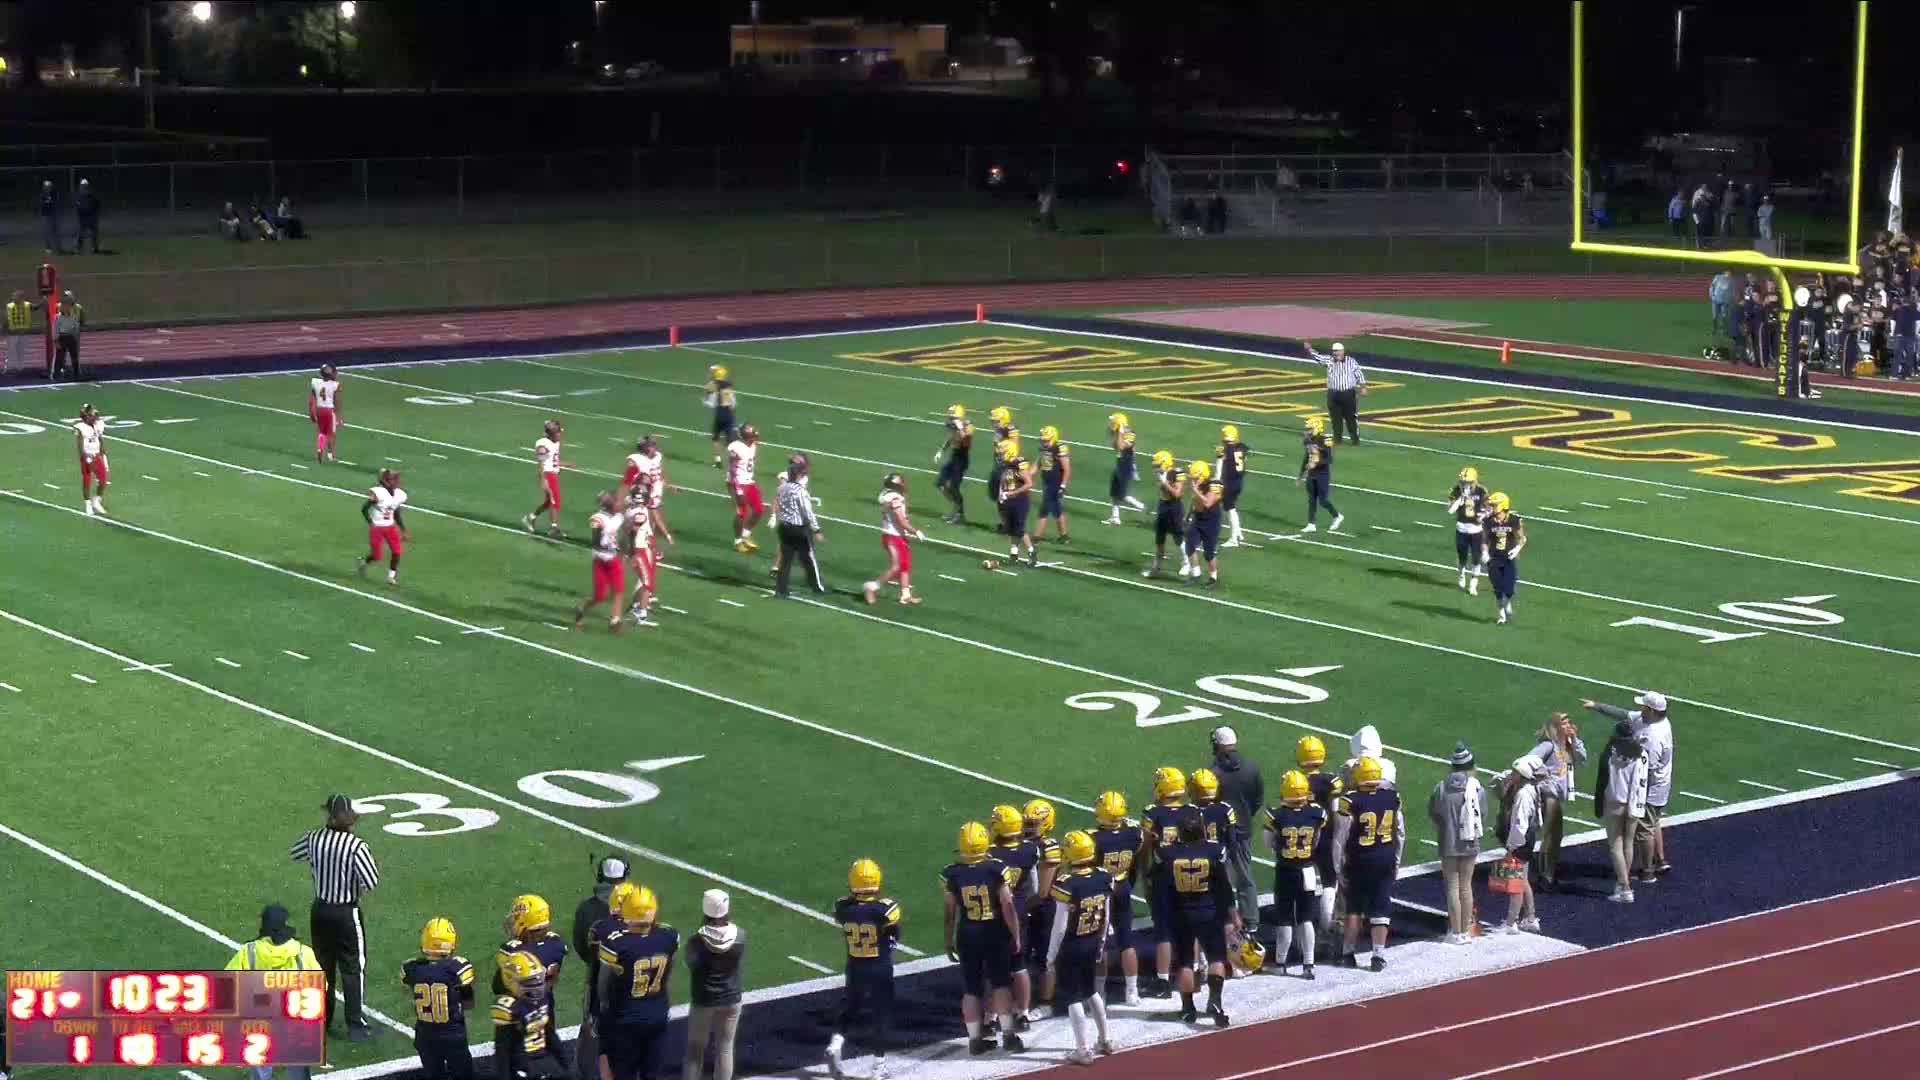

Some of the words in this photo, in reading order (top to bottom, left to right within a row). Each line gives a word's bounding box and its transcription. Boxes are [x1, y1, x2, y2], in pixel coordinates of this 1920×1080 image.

[1778, 311, 1790, 396] WILDCATS
[1608, 601, 1846, 644] 10
[1063, 673, 1330, 728] 20
[350, 769, 661, 836] 30
[1281, 826, 1315, 859] 33
[1359, 809, 1394, 847] 34
[1173, 858, 1210, 892] 62
[961, 885, 994, 920] 51
[845, 922, 879, 957] 22
[632, 956, 668, 998] 67
[413, 983, 449, 1024] 20
